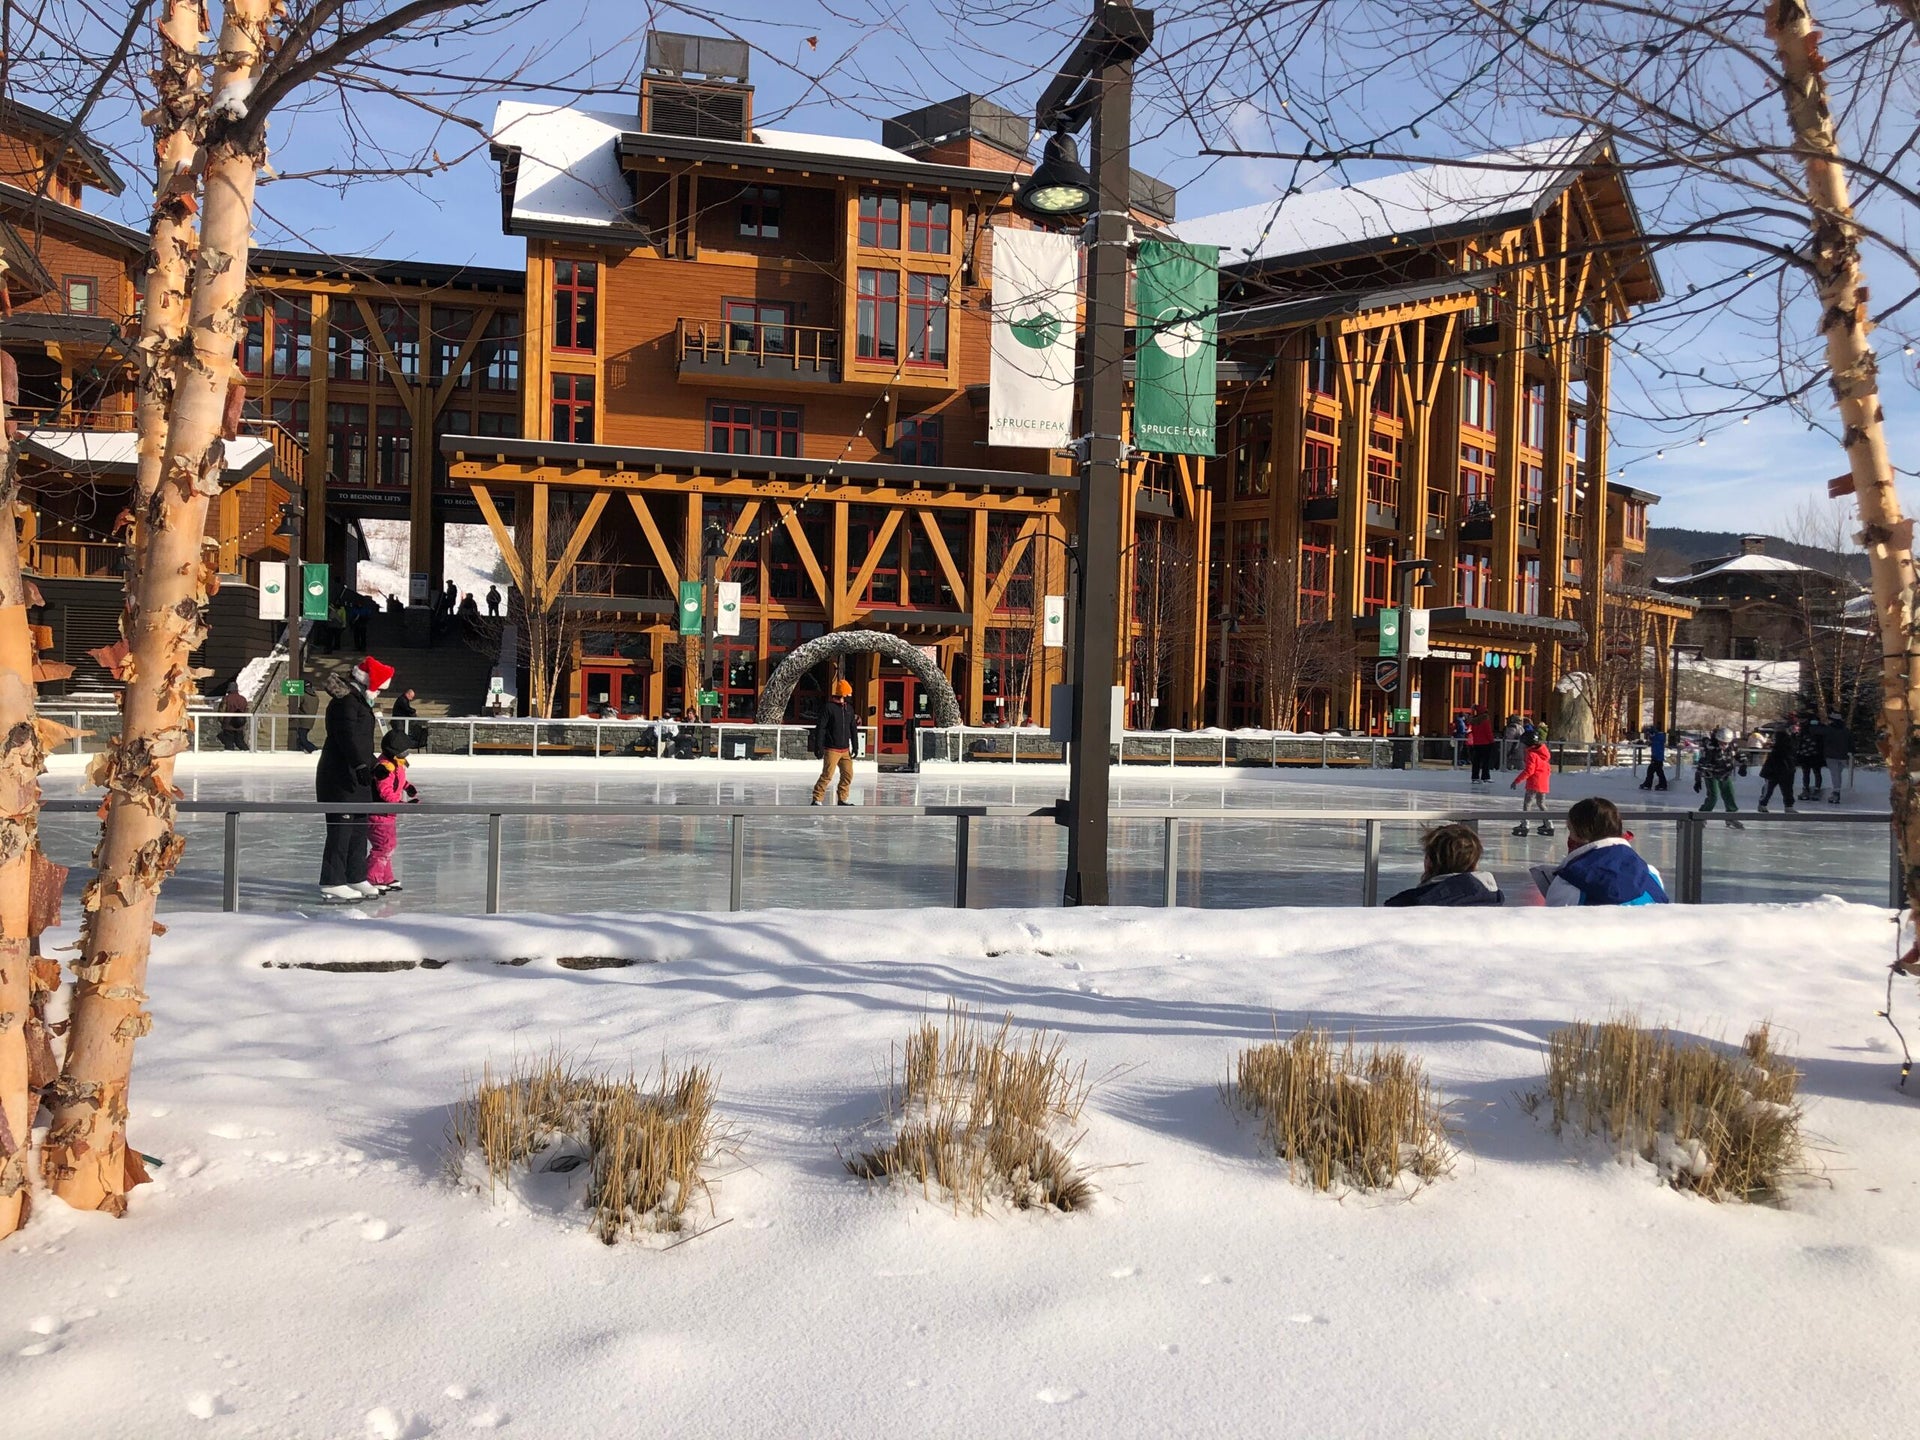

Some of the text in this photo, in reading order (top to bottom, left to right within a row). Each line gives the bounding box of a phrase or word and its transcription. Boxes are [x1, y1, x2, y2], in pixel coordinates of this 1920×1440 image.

[996, 418, 1064, 430] SPRUCE PEAK
[1141, 424, 1208, 437] SPRUCE PEAK
[350, 493, 382, 501] BEGINNER
